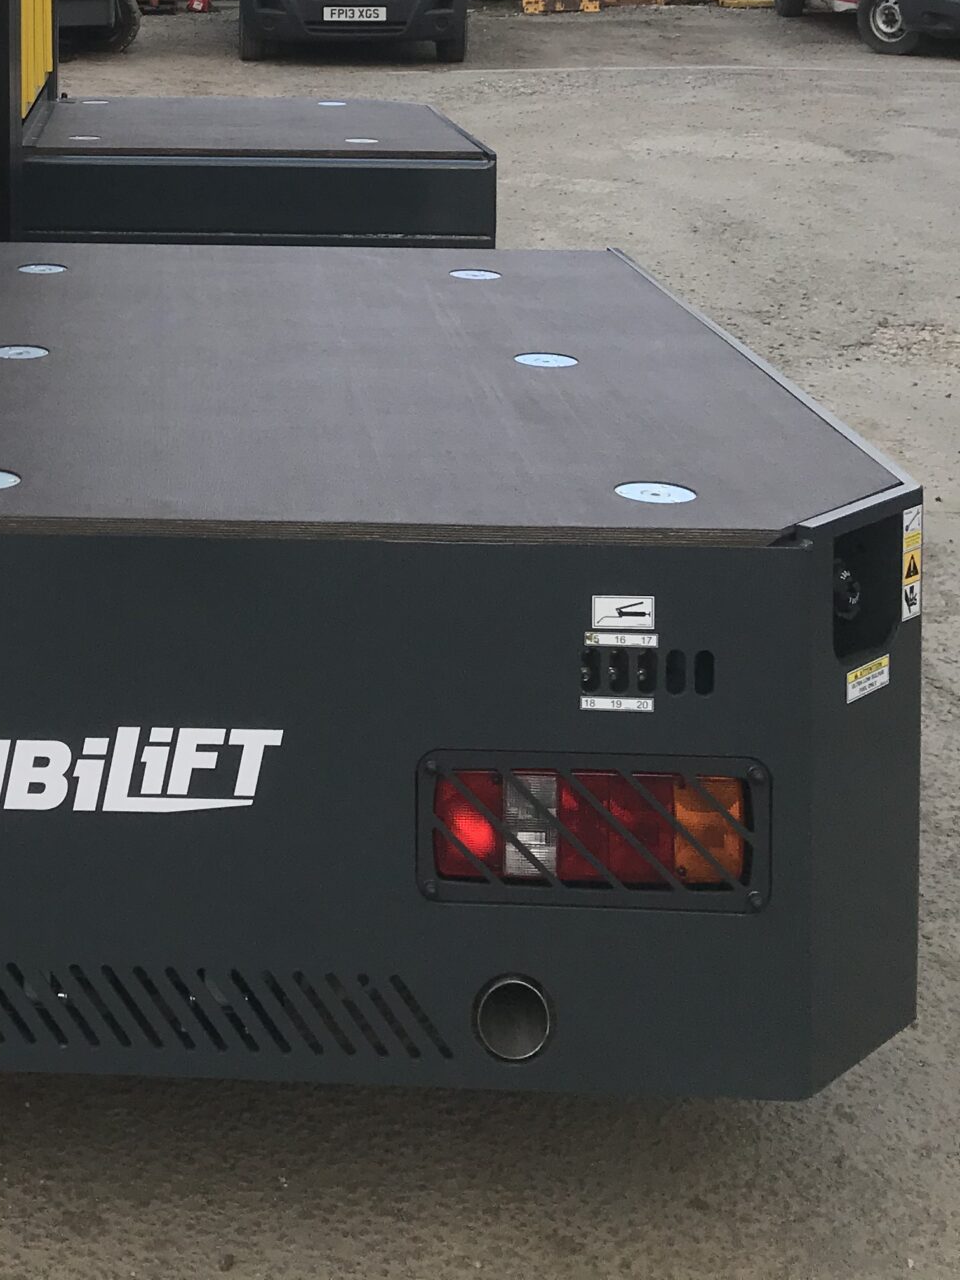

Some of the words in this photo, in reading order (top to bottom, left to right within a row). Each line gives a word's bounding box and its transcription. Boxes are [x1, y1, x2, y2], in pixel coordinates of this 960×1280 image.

[330, 8, 355, 19] FP13
[358, 8, 379, 19] XGS
[615, 636, 626, 644] 16
[642, 637, 653, 645] 17
[585, 699, 596, 708] 18
[611, 700, 622, 708] 19
[637, 700, 648, 709] 20
